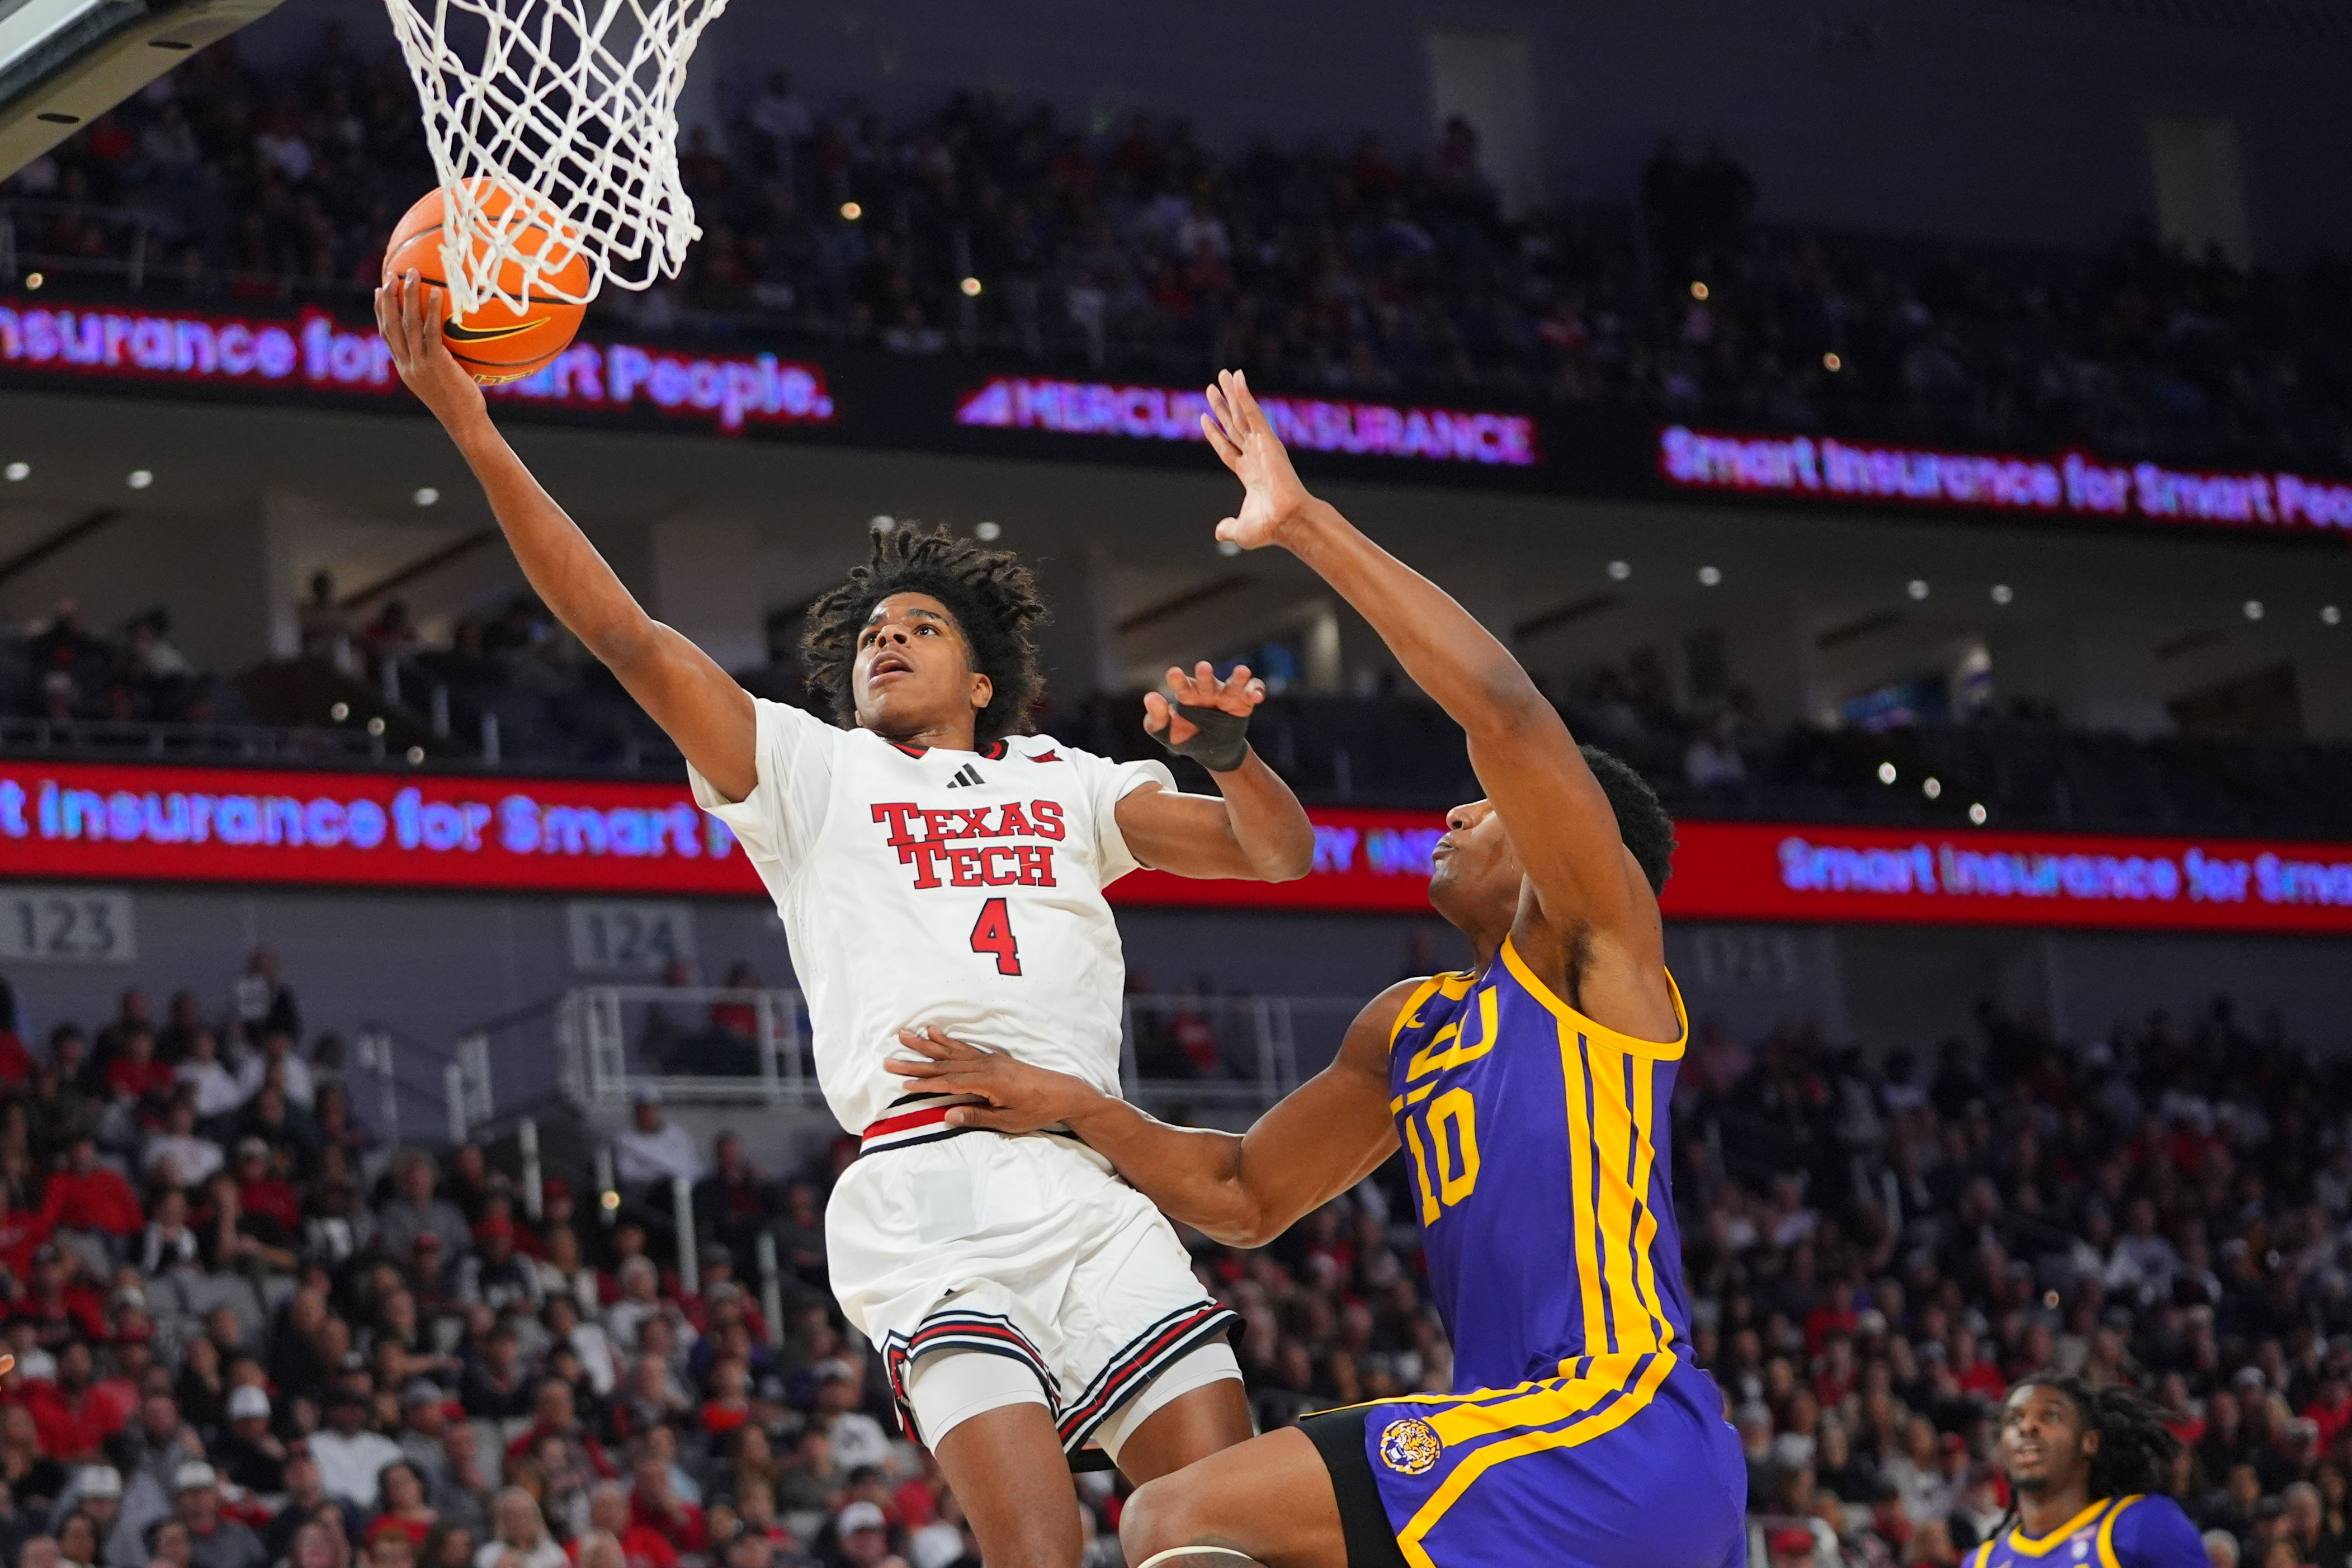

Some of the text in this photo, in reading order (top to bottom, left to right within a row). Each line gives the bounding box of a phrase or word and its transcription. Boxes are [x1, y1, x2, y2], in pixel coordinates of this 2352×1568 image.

[607, 343, 834, 426] People.
[1662, 425, 1821, 490] Smart
[1821, 436, 2062, 508] Insurance
[2063, 453, 2132, 512] for
[2133, 461, 2275, 524] Smart
[38, 779, 387, 849] Insurance
[393, 787, 492, 851] for
[497, 794, 702, 858] Smart
[870, 799, 1065, 847] TEXAS
[897, 840, 1057, 890] TECH
[1777, 837, 1937, 894] Smart
[1938, 842, 2180, 903] Insurance
[2182, 846, 2251, 904] for
[15, 898, 117, 953] 123
[970, 897, 1023, 977] 4
[1405, 1087, 1481, 1229] 10
